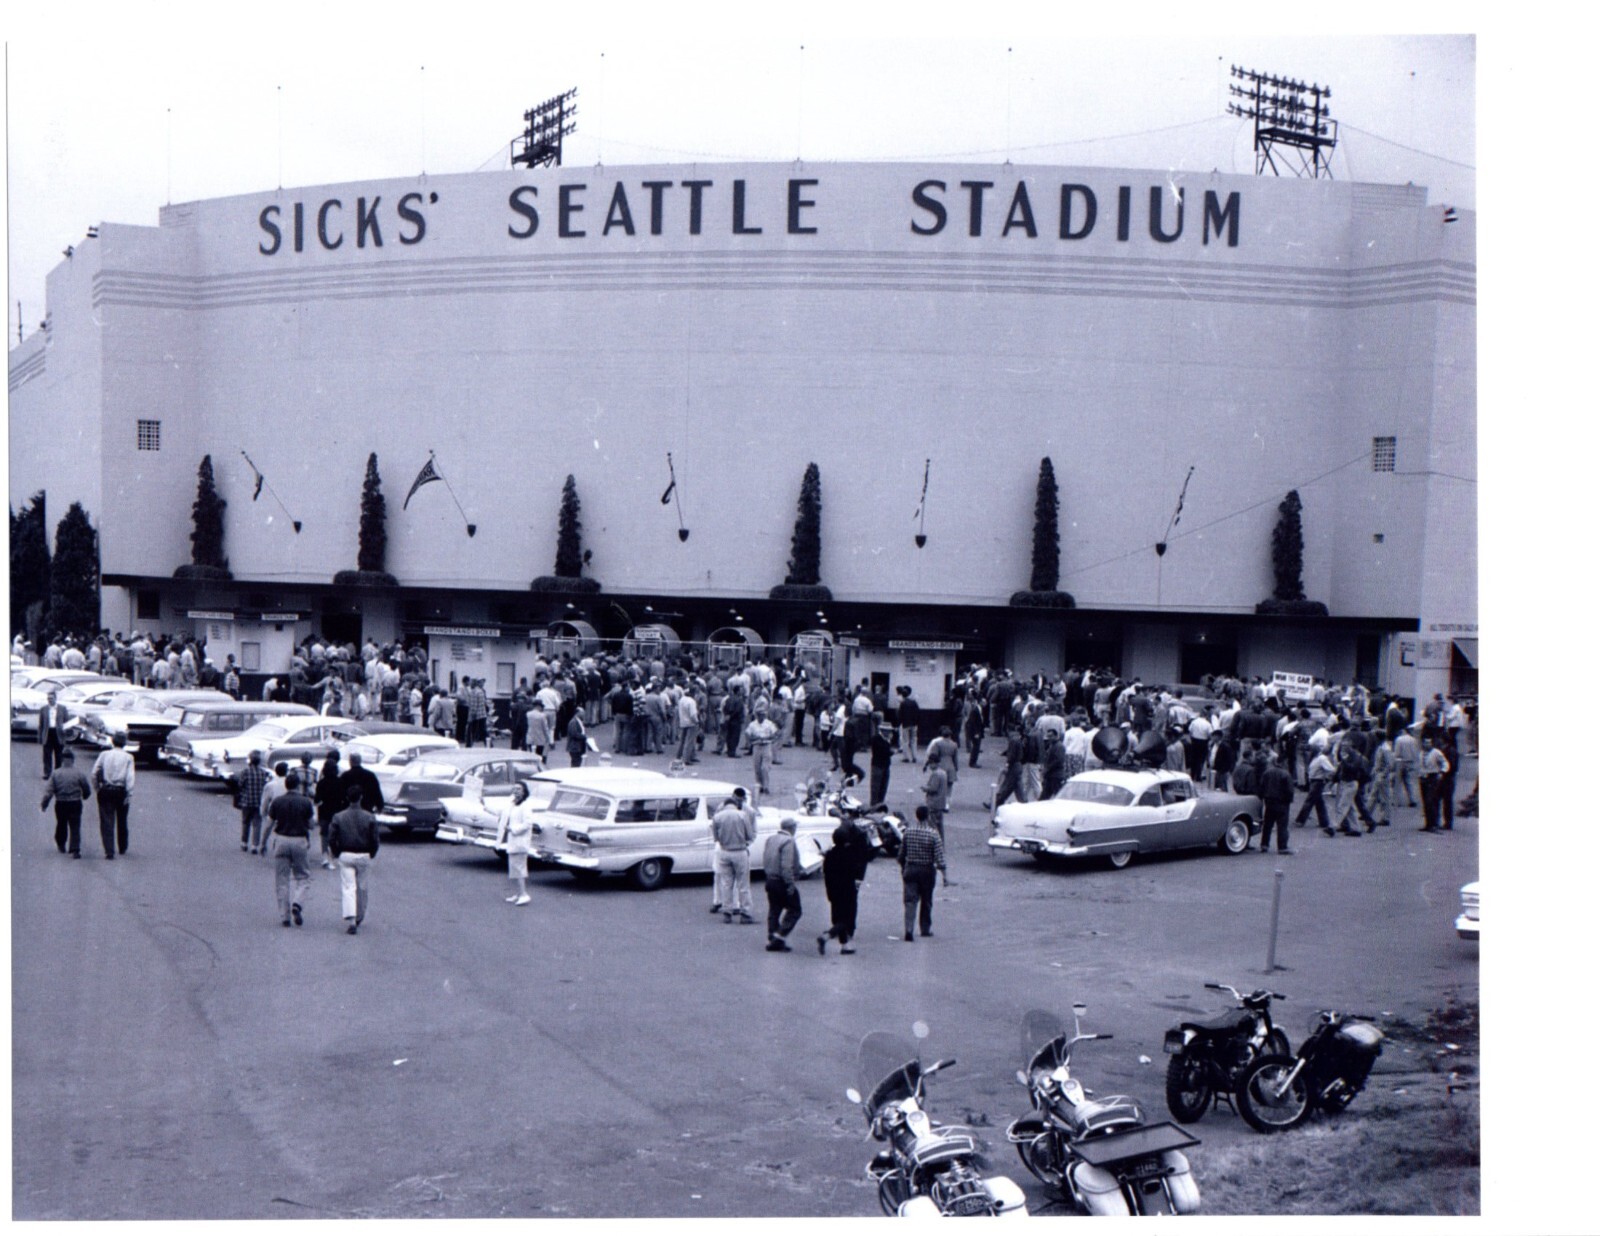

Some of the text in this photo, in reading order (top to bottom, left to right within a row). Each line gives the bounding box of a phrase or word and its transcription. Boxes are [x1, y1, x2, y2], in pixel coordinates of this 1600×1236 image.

[258, 179, 1241, 256] SICKS' SEATTLE STADIUM
